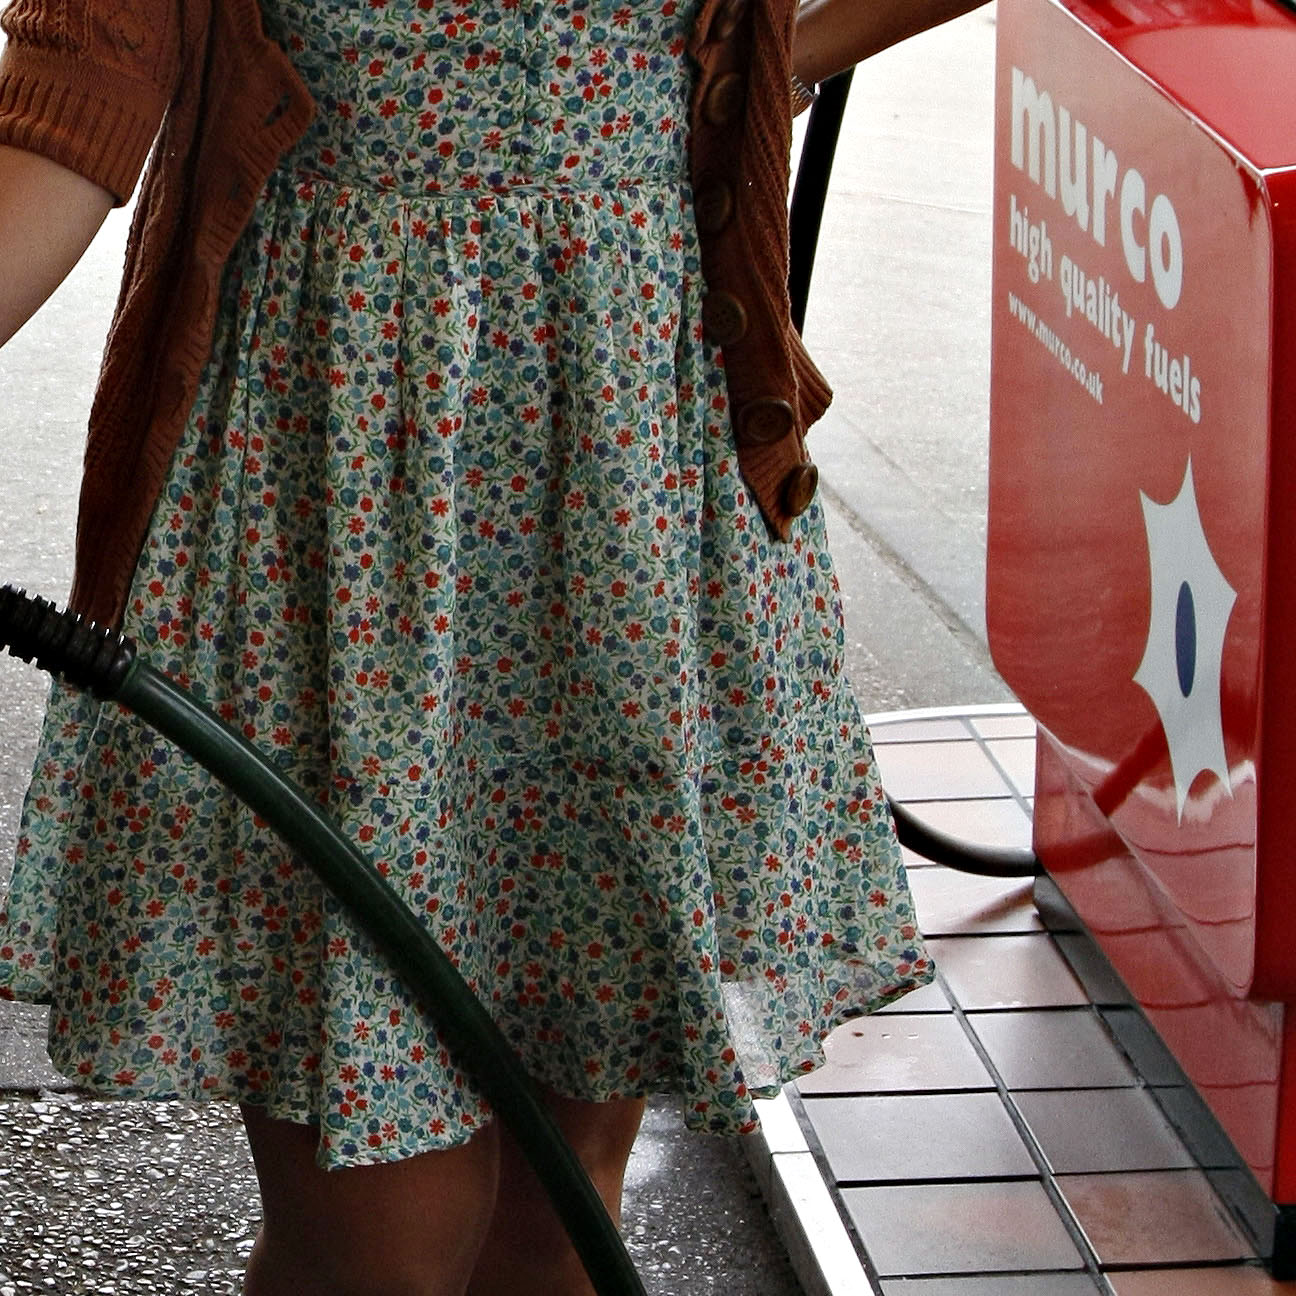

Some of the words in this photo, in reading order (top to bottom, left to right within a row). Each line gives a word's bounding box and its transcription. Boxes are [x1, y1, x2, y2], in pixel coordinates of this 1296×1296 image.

[1011, 66, 1183, 310] murco
[1008, 291, 1103, 405] www.murco.co.uk
[1010, 194, 1052, 284] high
[1060, 254, 1135, 375] quality
[1144, 322, 1200, 424] fuels
